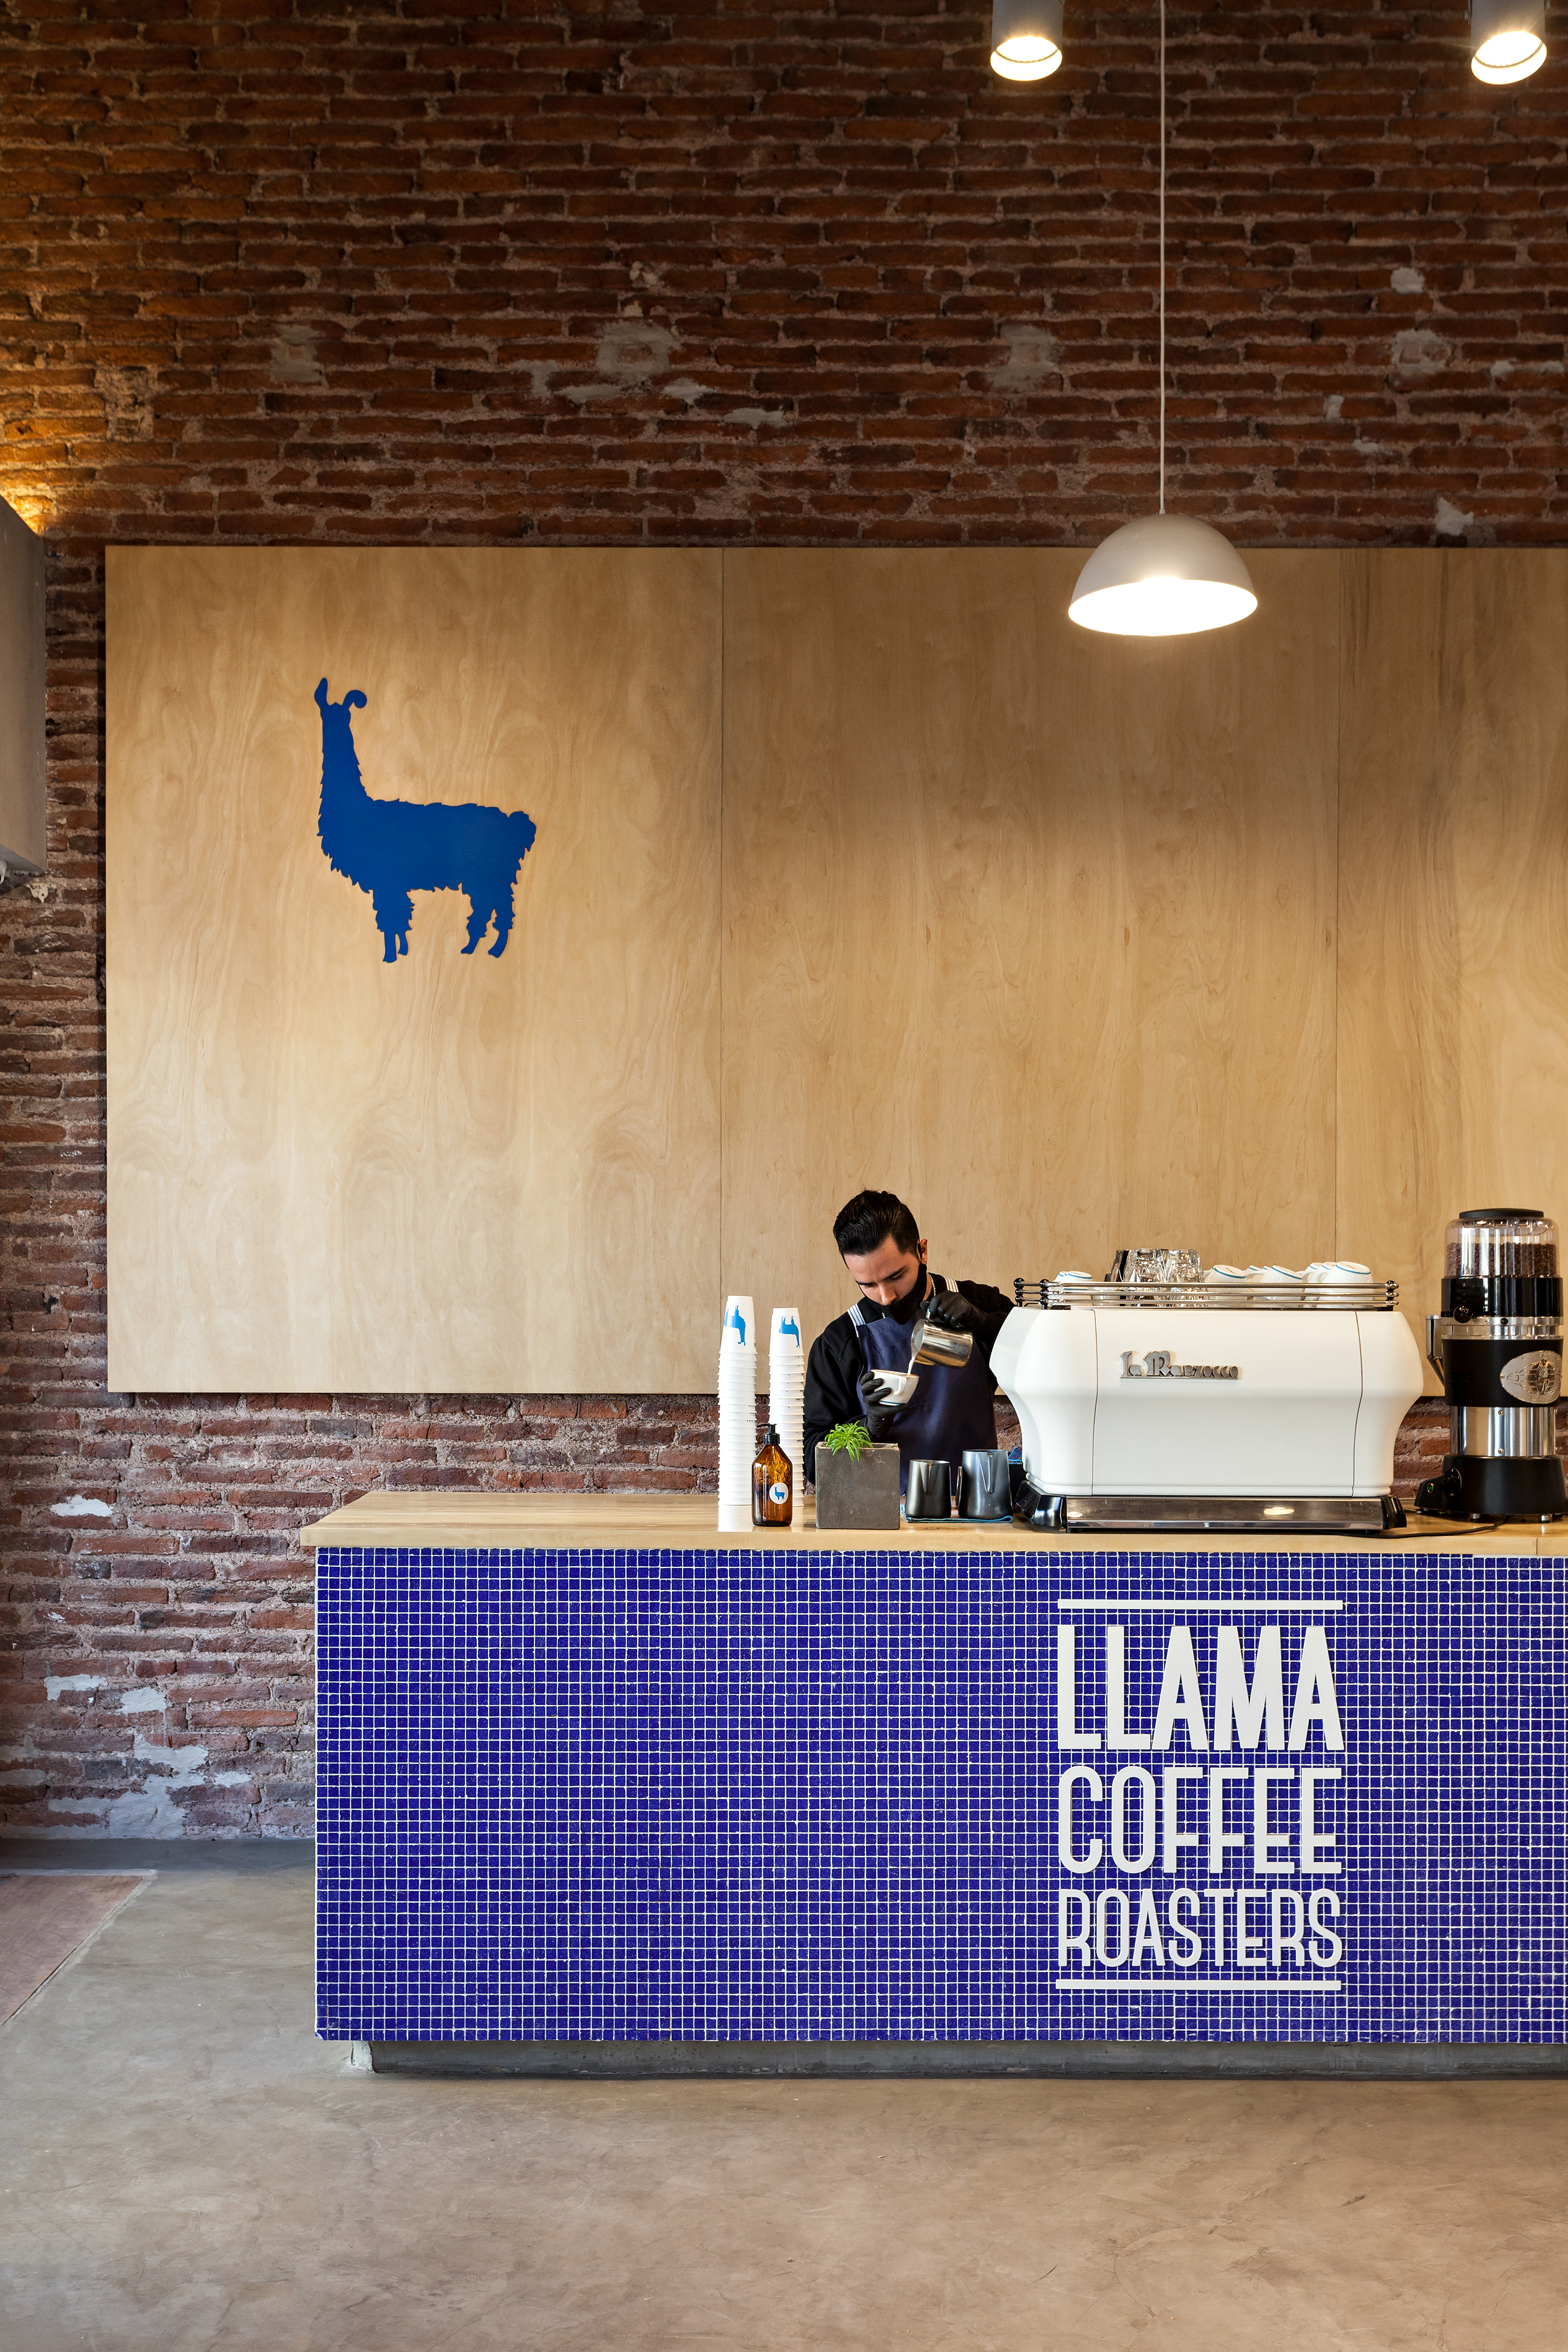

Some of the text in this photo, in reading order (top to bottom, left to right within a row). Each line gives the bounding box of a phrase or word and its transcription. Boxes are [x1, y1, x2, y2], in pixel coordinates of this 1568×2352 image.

[1120, 1350, 1239, 1379] La Marzocco
[1058, 1625, 1344, 1750] LLAMA
[1058, 1765, 1342, 1873] COFFEE
[1059, 1888, 1342, 1967] ROASTERS
